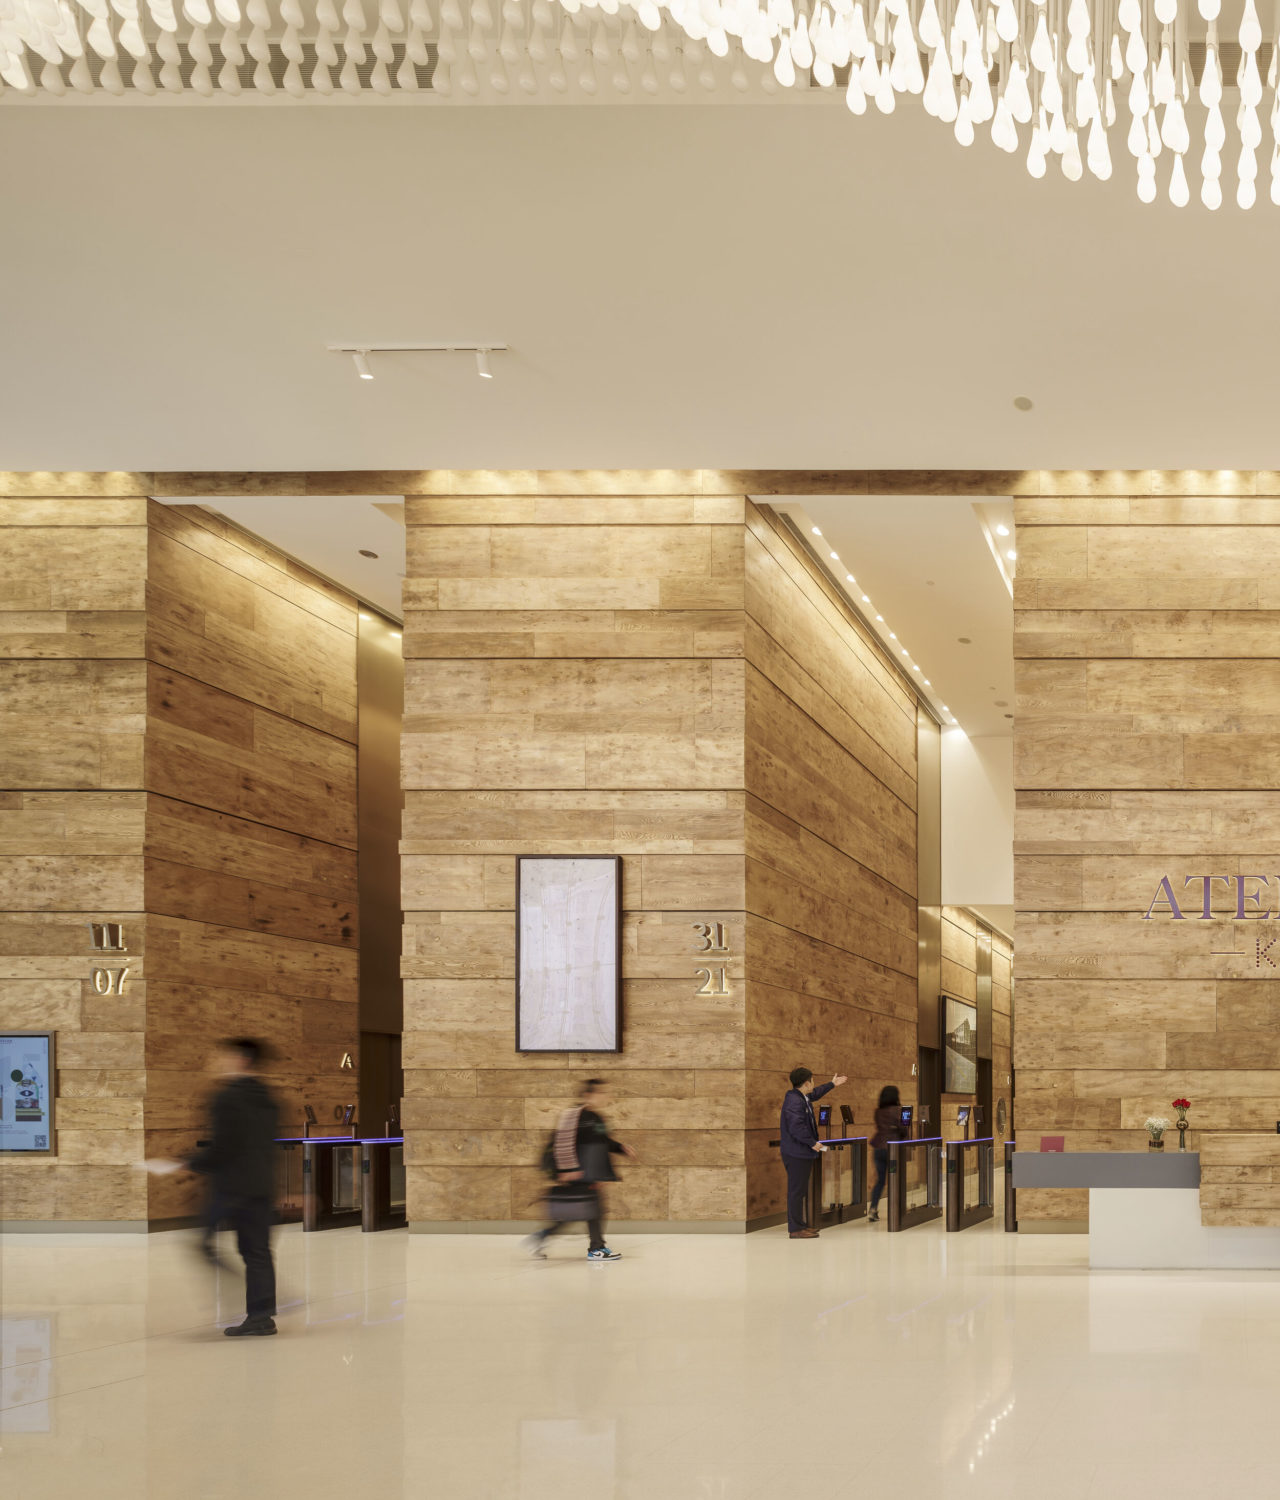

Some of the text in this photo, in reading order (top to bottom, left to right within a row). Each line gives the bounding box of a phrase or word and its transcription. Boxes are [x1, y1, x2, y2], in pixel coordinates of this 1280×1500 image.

[85, 922, 127, 951] 11
[690, 921, 729, 951] 31
[89, 967, 129, 995] 07
[694, 967, 729, 995] 21
[340, 1052, 355, 1070] A
